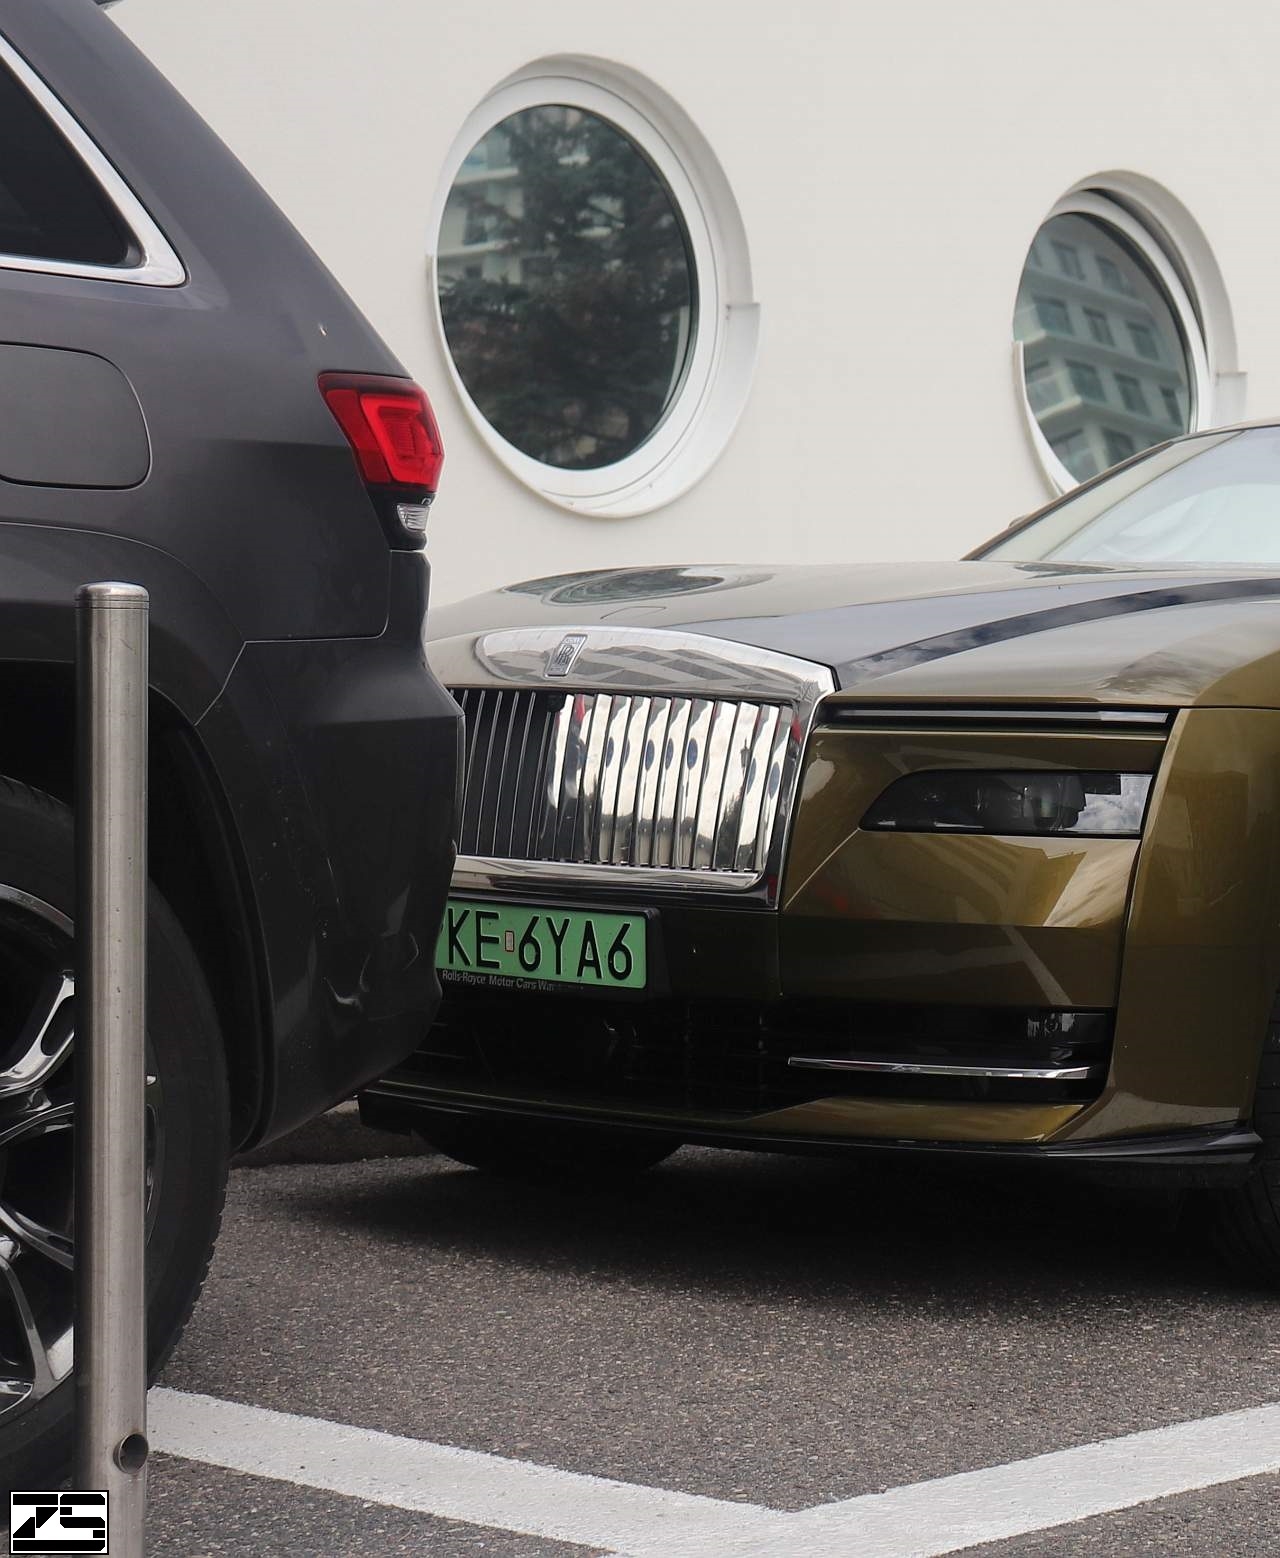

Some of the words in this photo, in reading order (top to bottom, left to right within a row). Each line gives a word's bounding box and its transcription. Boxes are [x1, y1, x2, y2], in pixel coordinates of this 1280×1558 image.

[518, 915, 634, 981] 6YA6
[442, 969, 486, 986] Rolls-Royce
[488, 974, 515, 989] Motor
